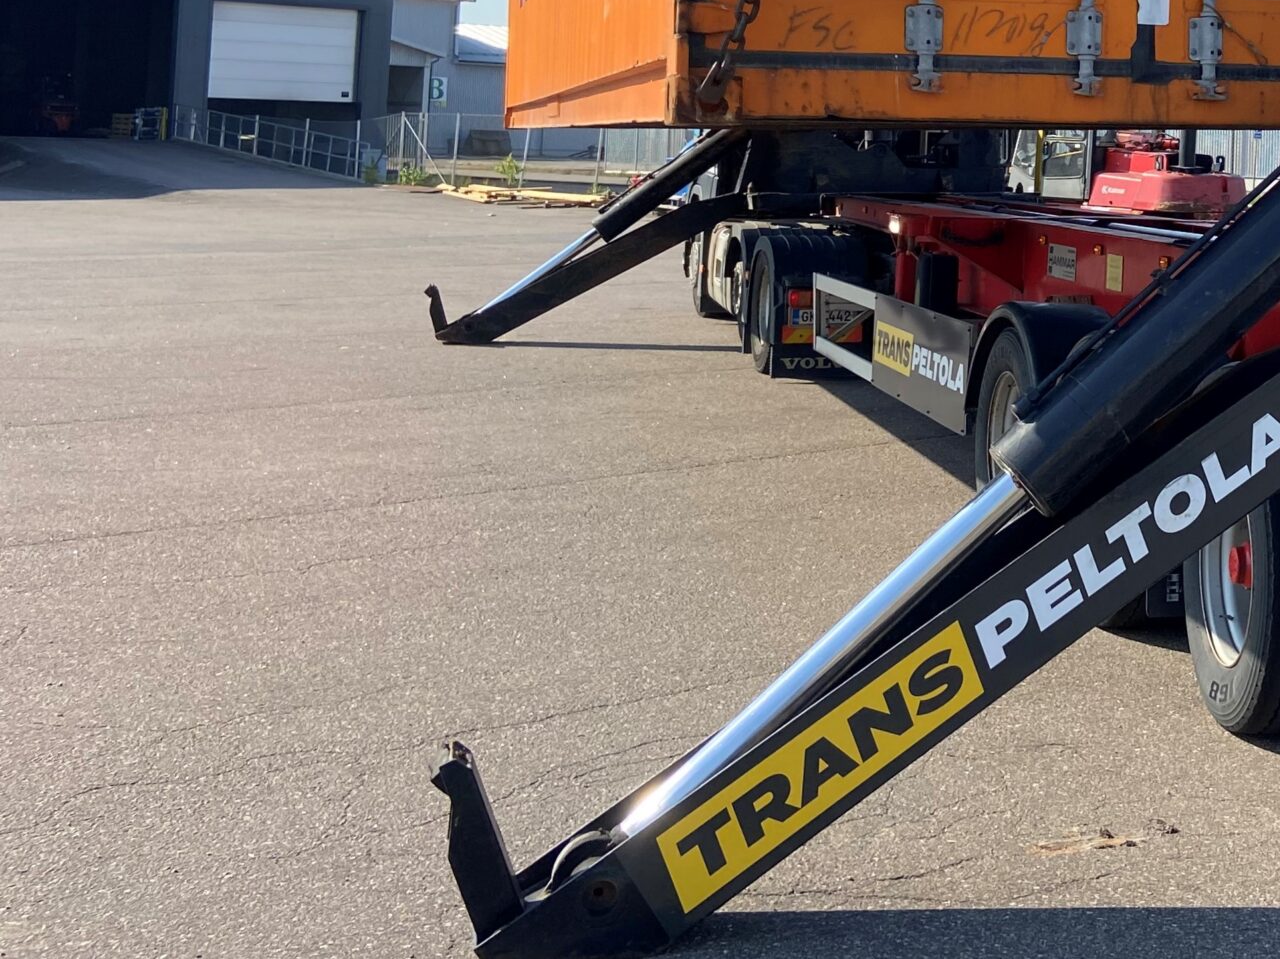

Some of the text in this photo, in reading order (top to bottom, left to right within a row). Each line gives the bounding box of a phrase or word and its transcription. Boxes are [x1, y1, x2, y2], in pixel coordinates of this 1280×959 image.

[780, 357, 843, 370] VOL
[877, 330, 964, 394] TRANS PELTOLA
[677, 648, 964, 876] TRANS
